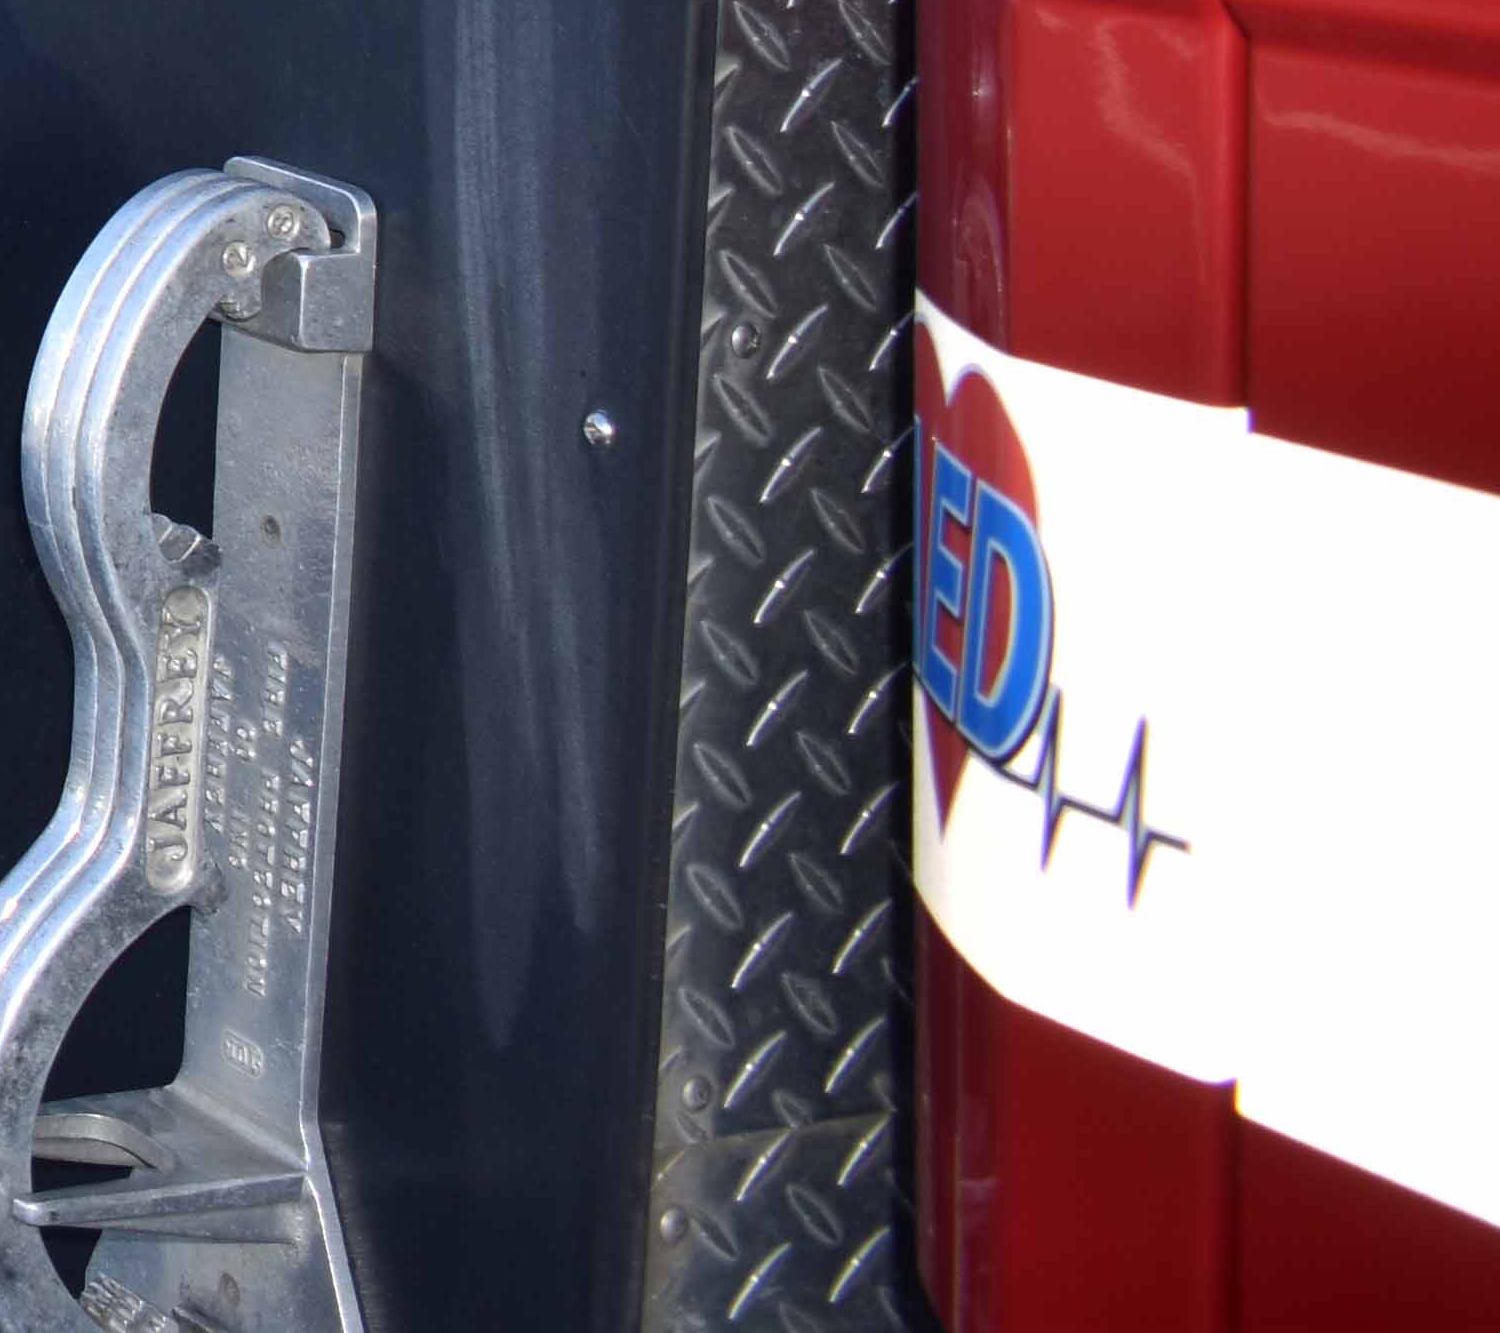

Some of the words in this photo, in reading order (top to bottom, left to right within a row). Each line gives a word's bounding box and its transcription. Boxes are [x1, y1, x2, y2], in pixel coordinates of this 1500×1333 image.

[263, 642, 289, 735] FIRE
[914, 415, 1054, 761] ED
[148, 605, 200, 862] JAFFREY
[245, 772, 281, 996] PROTECTION
